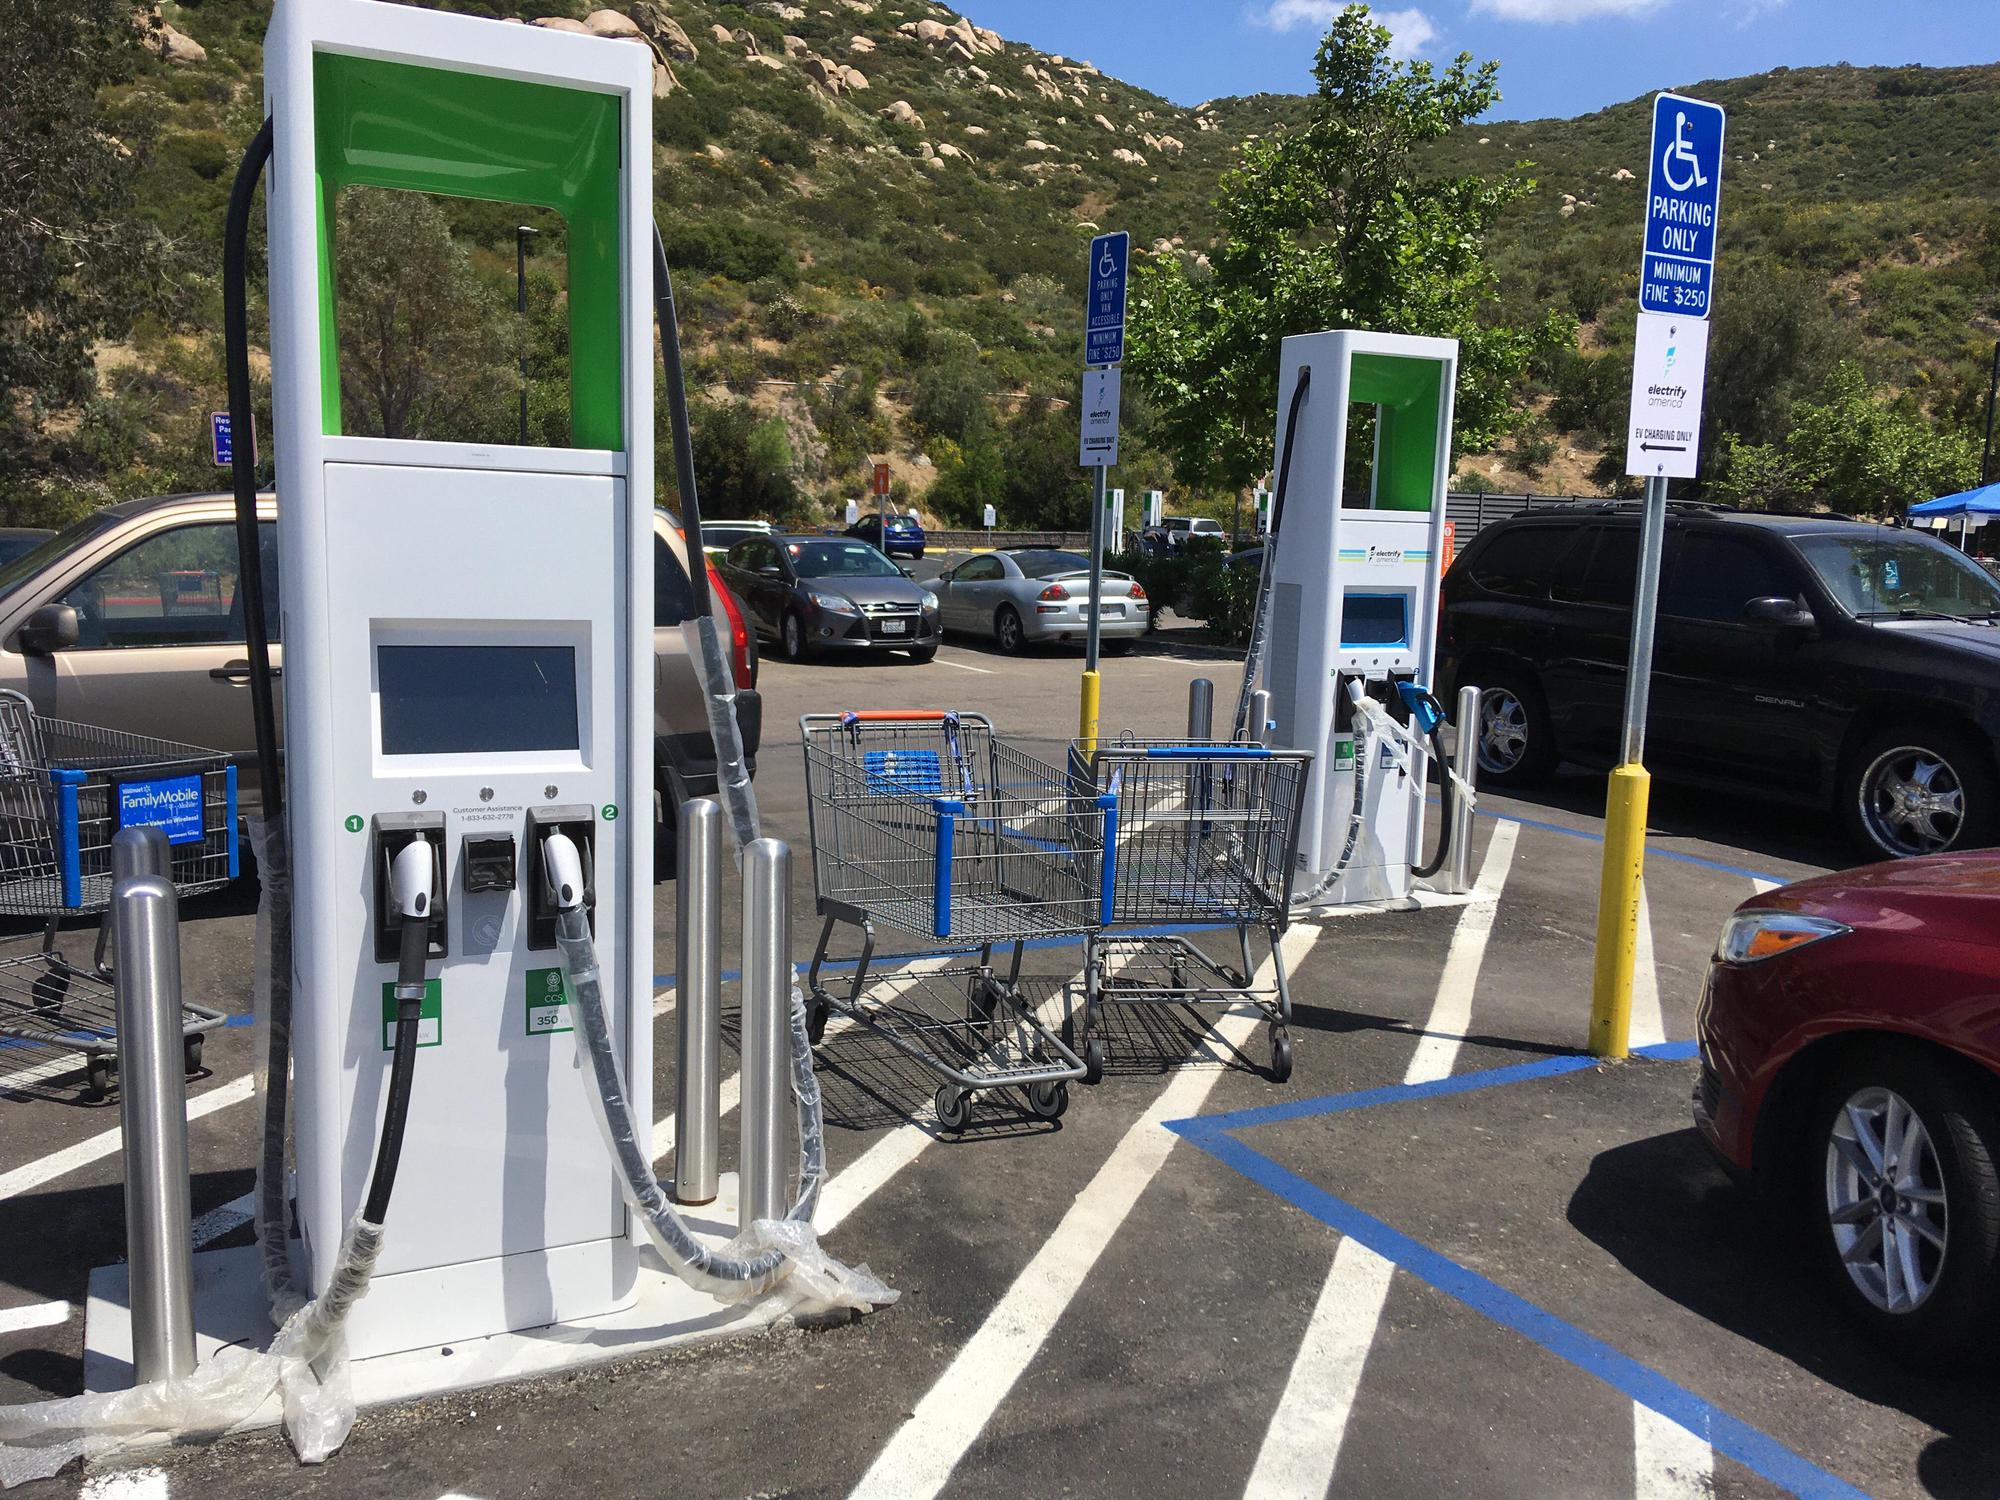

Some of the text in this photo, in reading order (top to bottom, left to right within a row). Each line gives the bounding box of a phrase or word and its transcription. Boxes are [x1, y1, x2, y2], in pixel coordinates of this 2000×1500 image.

[1652, 195, 1712, 227] PARKING
[1662, 225, 1698, 253] ONLY
[1653, 261, 1702, 284] MINIMUM
[1096, 278, 1118, 291] PARKING
[1100, 291, 1113, 302] ONLY
[1645, 283, 1706, 308] FINE $250
[1101, 302, 1111, 313] VAN
[1091, 313, 1120, 326] ACCESSIBLE
[1092, 331, 1117, 345] MINIMUM
[1088, 348, 1100, 360] FINE
[1648, 384, 1687, 399] electrify
[1648, 397, 1683, 409] america
[1090, 409, 1111, 418] electrify
[1090, 417, 1110, 425] america
[1635, 428, 1693, 442] EV CHARGING ONLY
[1376, 550, 1401, 558] electrify
[1755, 695, 1804, 707] DENALI
[122, 788, 199, 810] FamilyMobile
[149, 819, 166, 827] Value
[166, 817, 173, 825] in
[461, 813, 514, 822] 1-833-632-2778
[544, 993, 563, 1003] CCS
[537, 1015, 558, 1026] 350
